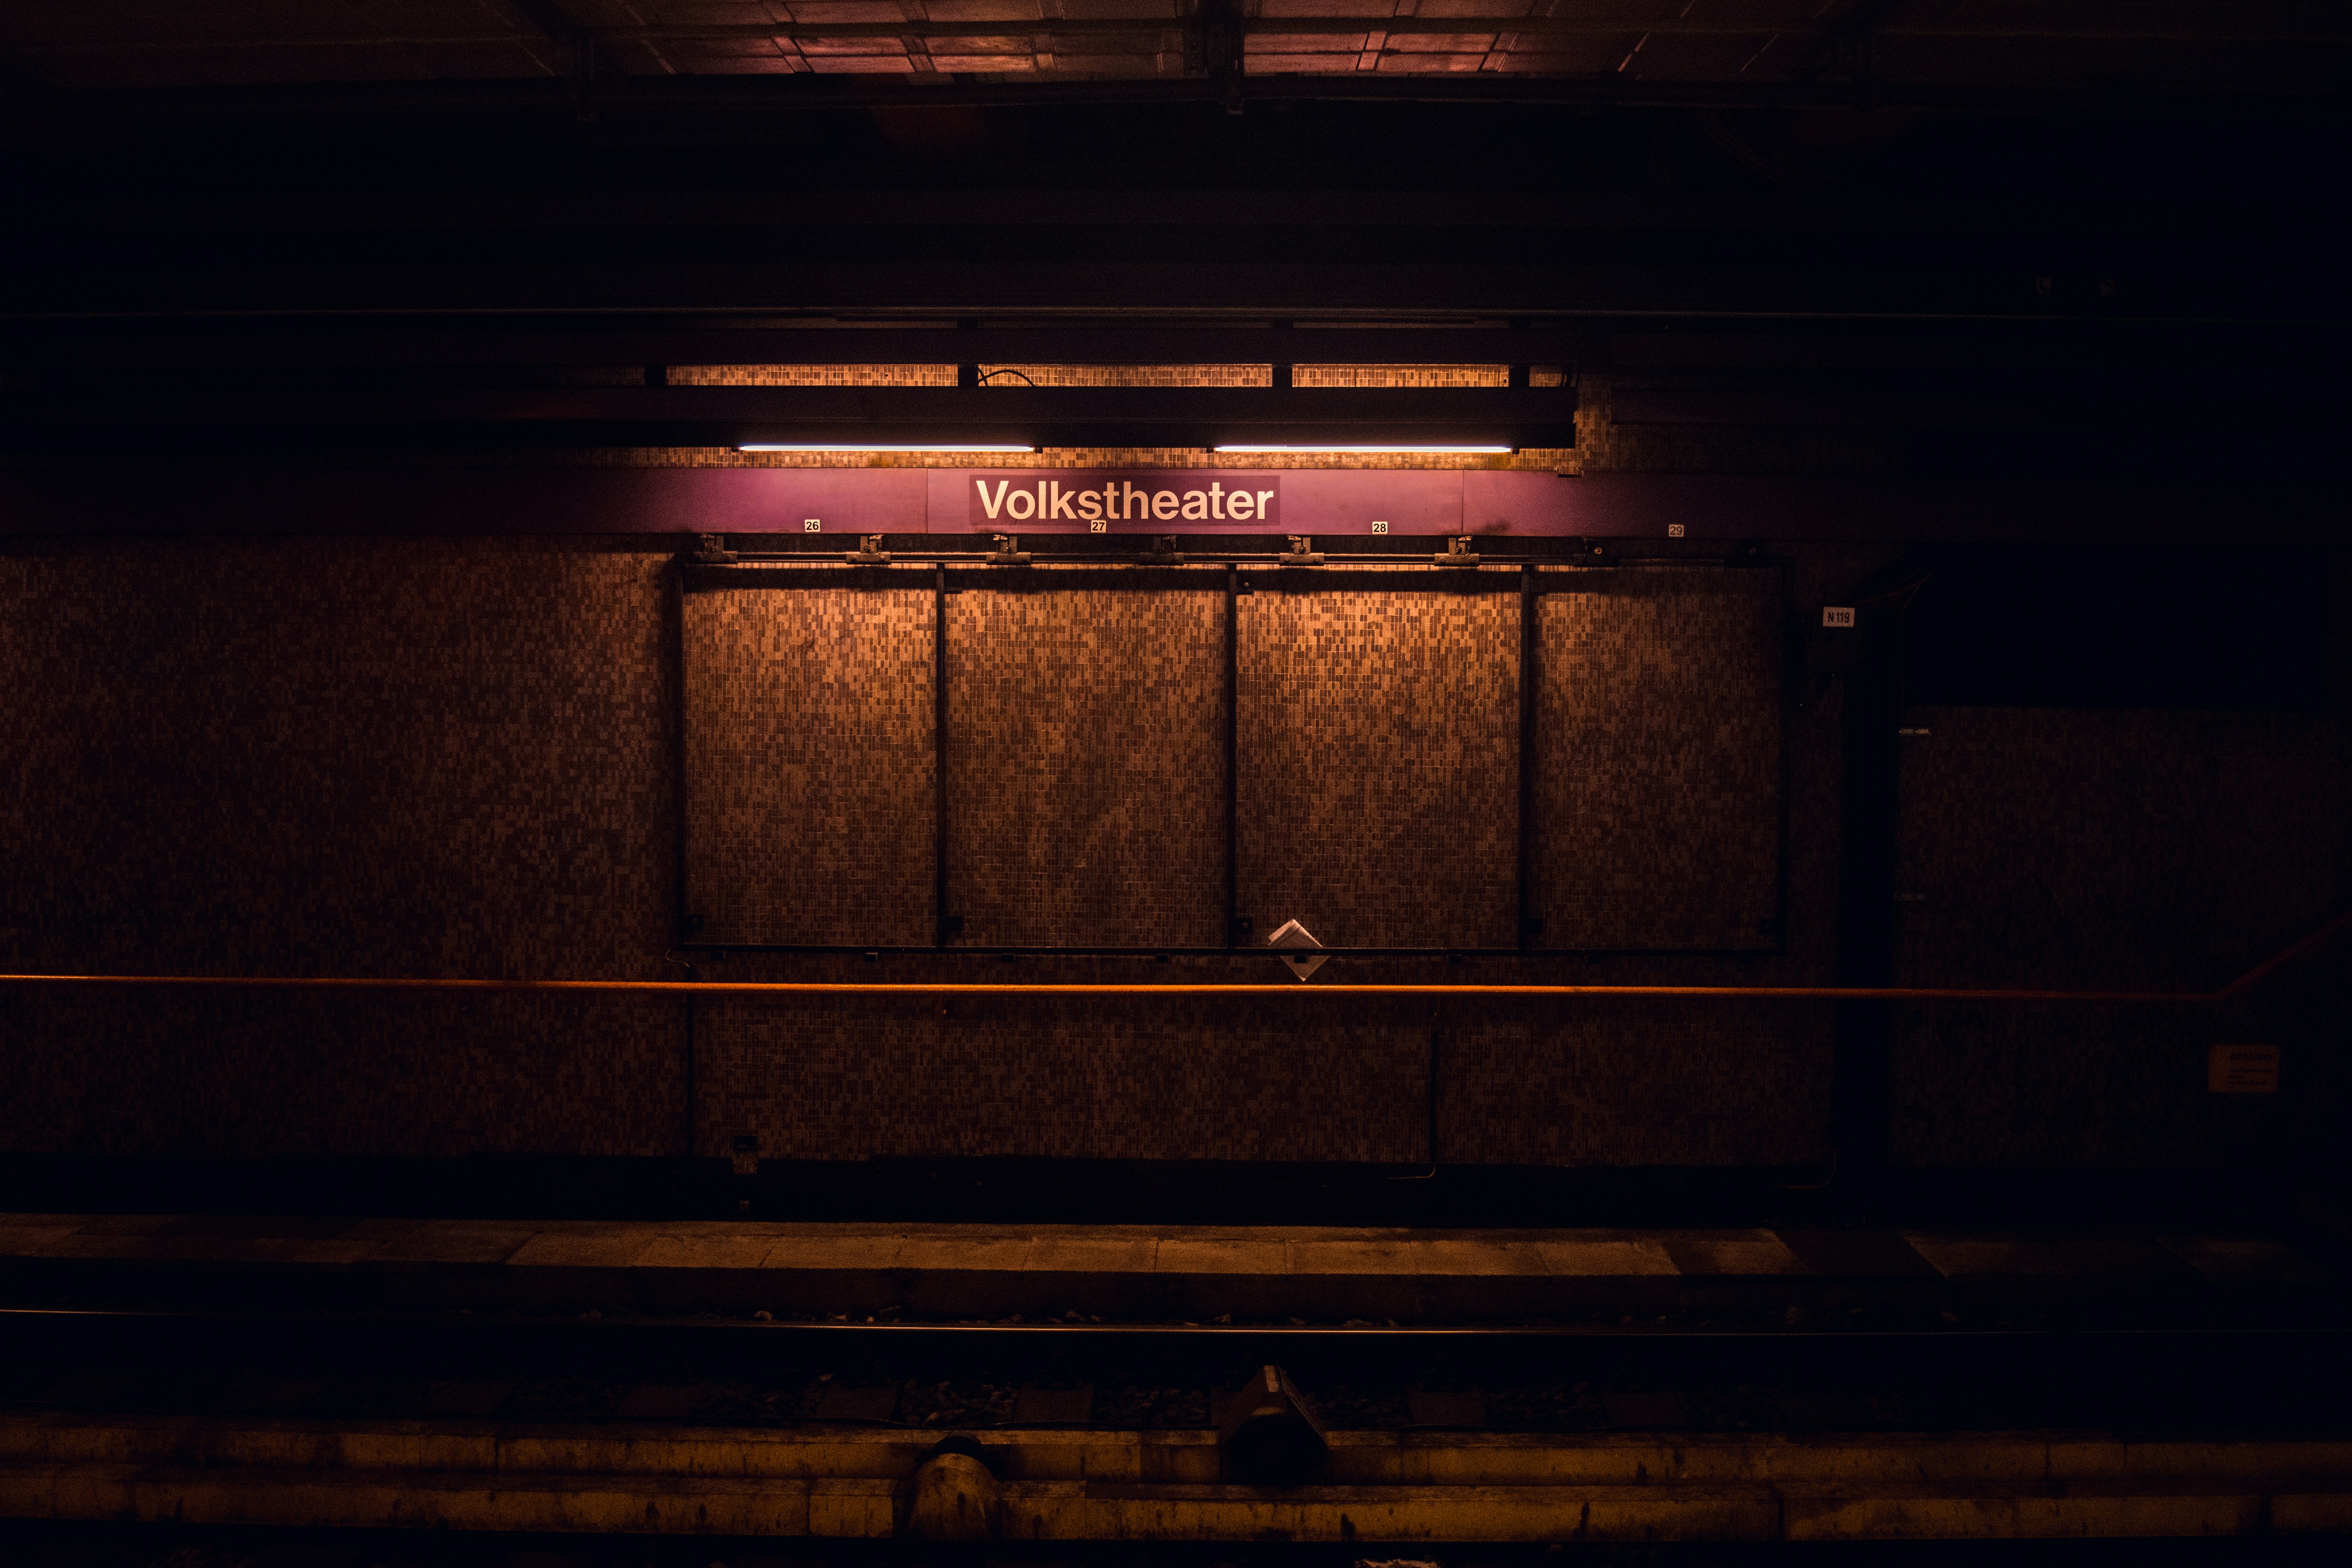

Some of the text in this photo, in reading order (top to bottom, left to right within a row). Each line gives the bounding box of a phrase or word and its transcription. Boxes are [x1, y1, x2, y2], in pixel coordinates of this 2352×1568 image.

[976, 481, 1273, 520] Volkstheater
[806, 522, 819, 530] 26
[1092, 522, 1105, 531] 27
[1374, 524, 1386, 532] 28
[1670, 526, 1682, 535] 29
[1828, 612, 1849, 623] N 119
